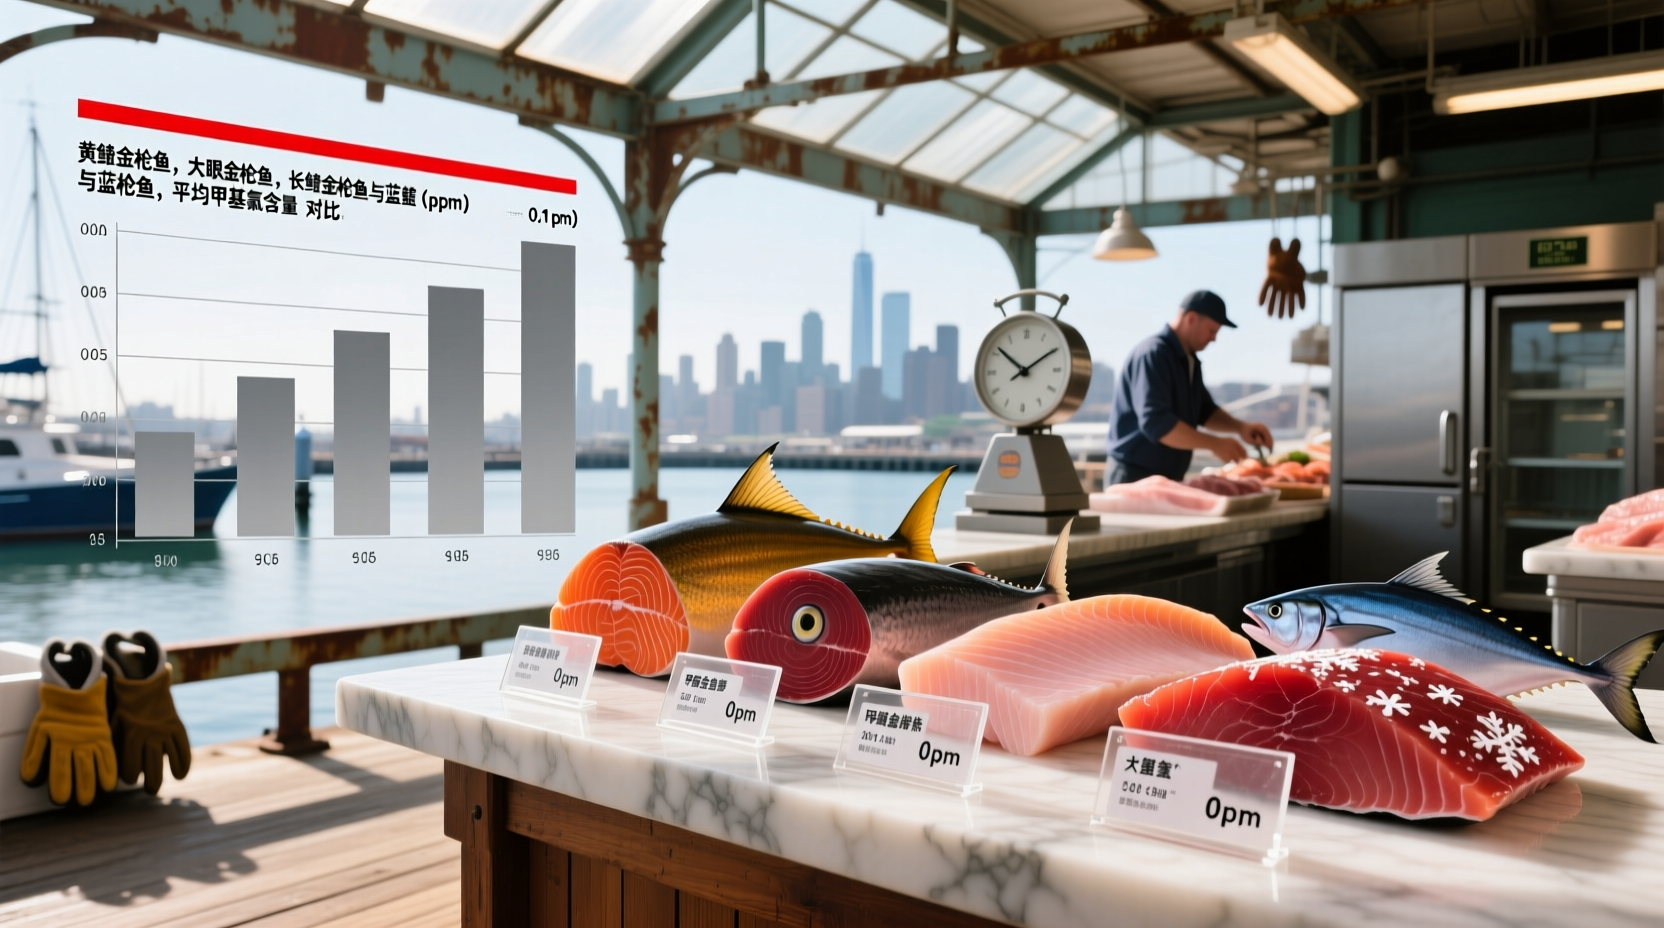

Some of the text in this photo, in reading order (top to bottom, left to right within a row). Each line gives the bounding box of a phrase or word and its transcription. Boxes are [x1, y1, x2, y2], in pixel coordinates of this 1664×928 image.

[725, 700, 757, 724] 0pm
[918, 740, 961, 768] 0pm
[1205, 796, 1261, 828] 0pm
